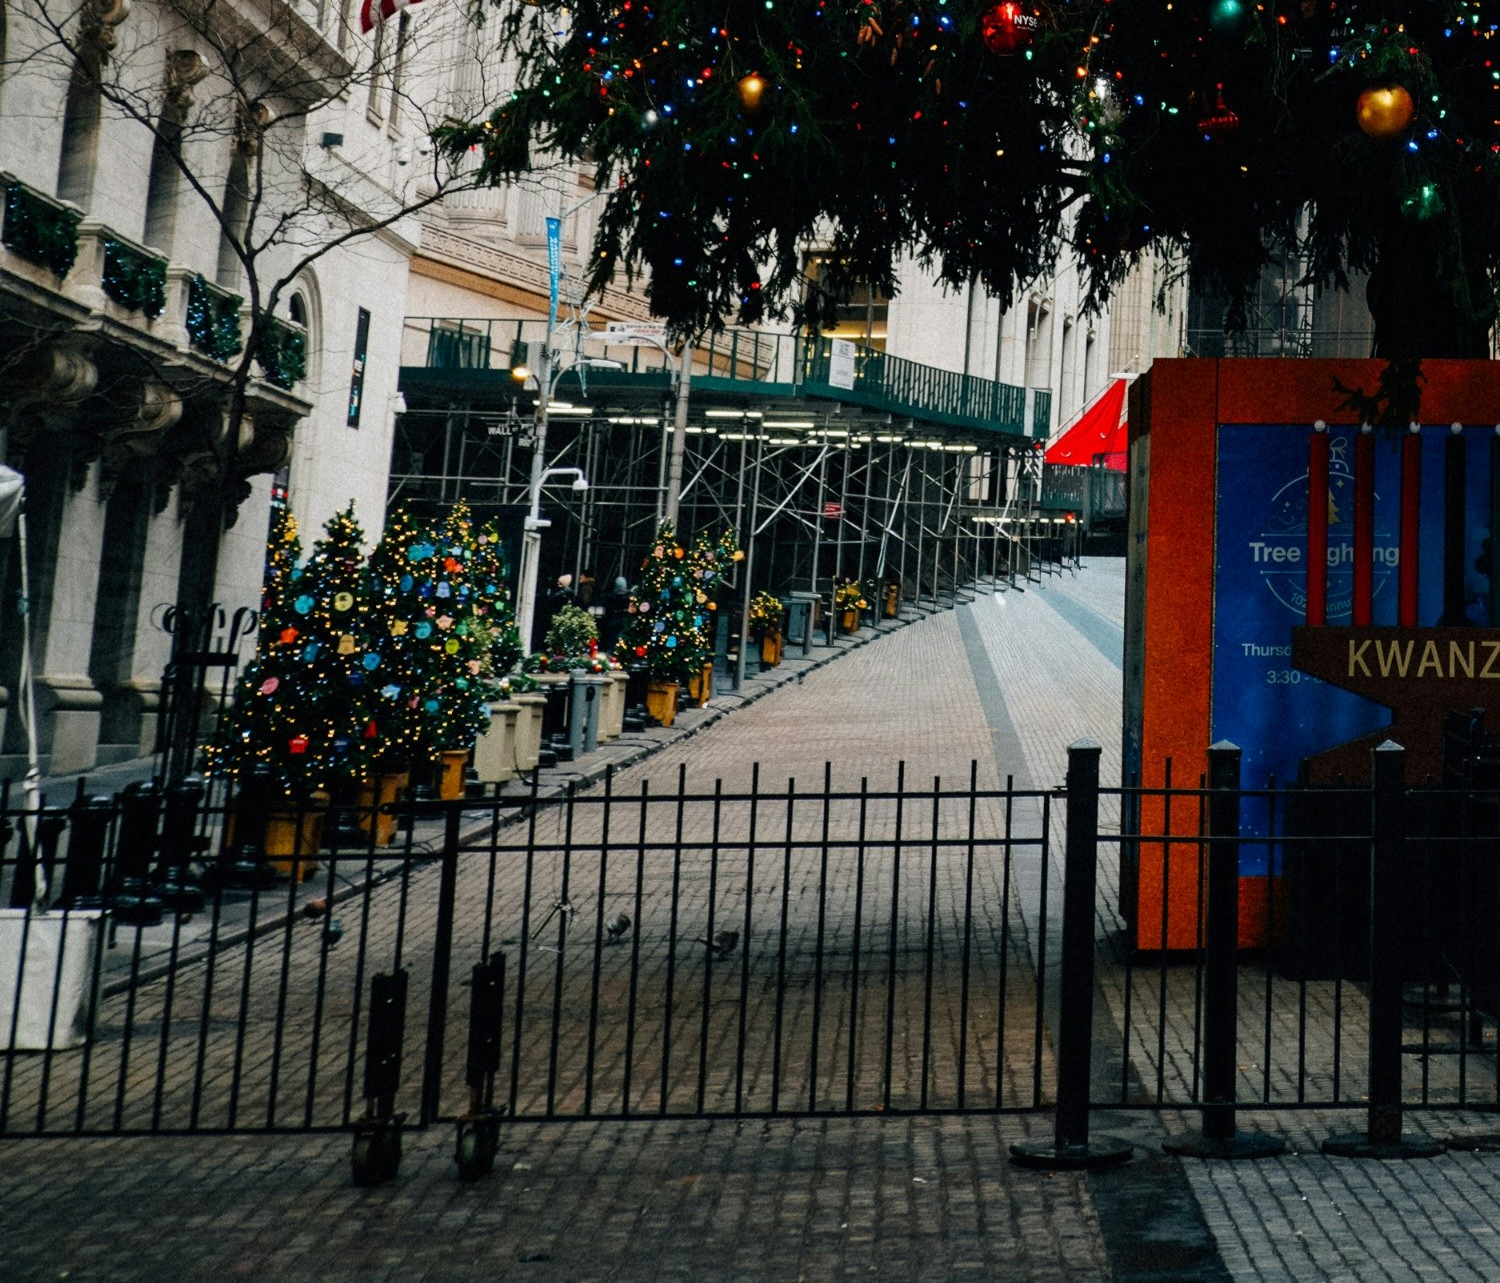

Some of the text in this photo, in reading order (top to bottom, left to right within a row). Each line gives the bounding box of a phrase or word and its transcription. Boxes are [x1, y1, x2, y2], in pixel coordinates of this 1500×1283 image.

[488, 426, 512, 436] WALL
[1249, 541, 1301, 563] Tree
[1267, 669, 1300, 684] 3:30
